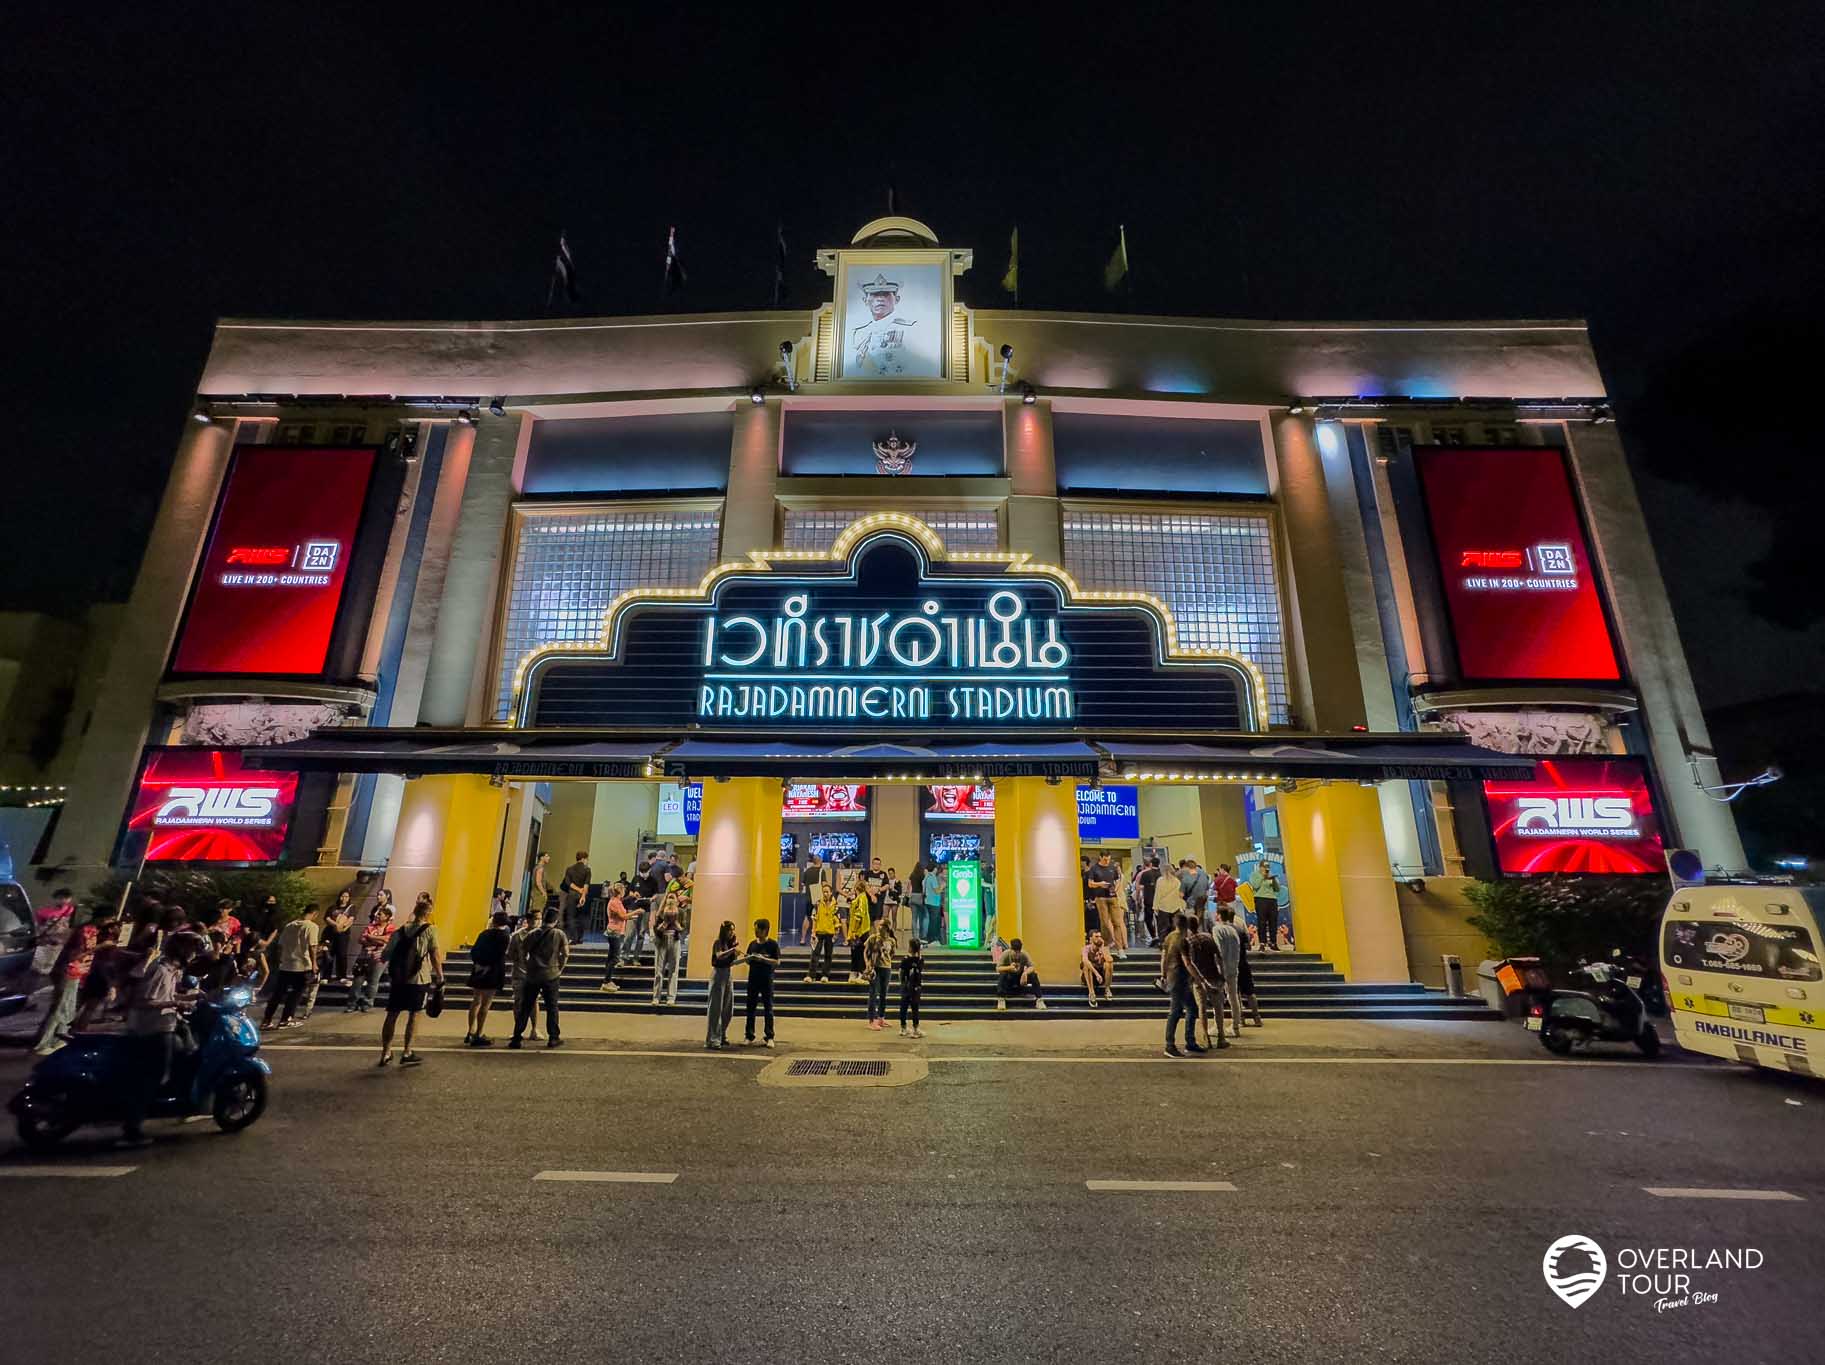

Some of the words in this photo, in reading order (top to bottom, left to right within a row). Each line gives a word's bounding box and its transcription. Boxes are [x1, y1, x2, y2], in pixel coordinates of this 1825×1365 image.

[223, 575, 243, 584] LIVE
[244, 575, 255, 584] IN
[256, 575, 278, 584] 200+
[280, 576, 329, 585] COUNTRIES
[1467, 578, 1488, 588] LIVE
[1489, 579, 1499, 588] IN
[1502, 579, 1524, 588] 200+
[1527, 579, 1577, 588] COUNTRIES
[700, 685, 929, 719] RAJADAMNERN
[948, 686, 1072, 719] STADIUM
[1042, 762, 1093, 776] STADIUM
[157, 787, 280, 817] RWS
[1107, 791, 1117, 803] TO
[663, 803, 679, 811] LEO
[1517, 797, 1632, 828] RWS
[155, 817, 214, 825] RAJADAMNERN
[1517, 828, 1579, 836] RAJADAMNERN
[1235, 852, 1260, 865] MUAY
[1264, 852, 1284, 864] THAI
[1695, 1020, 1808, 1051] AMBULANCE
